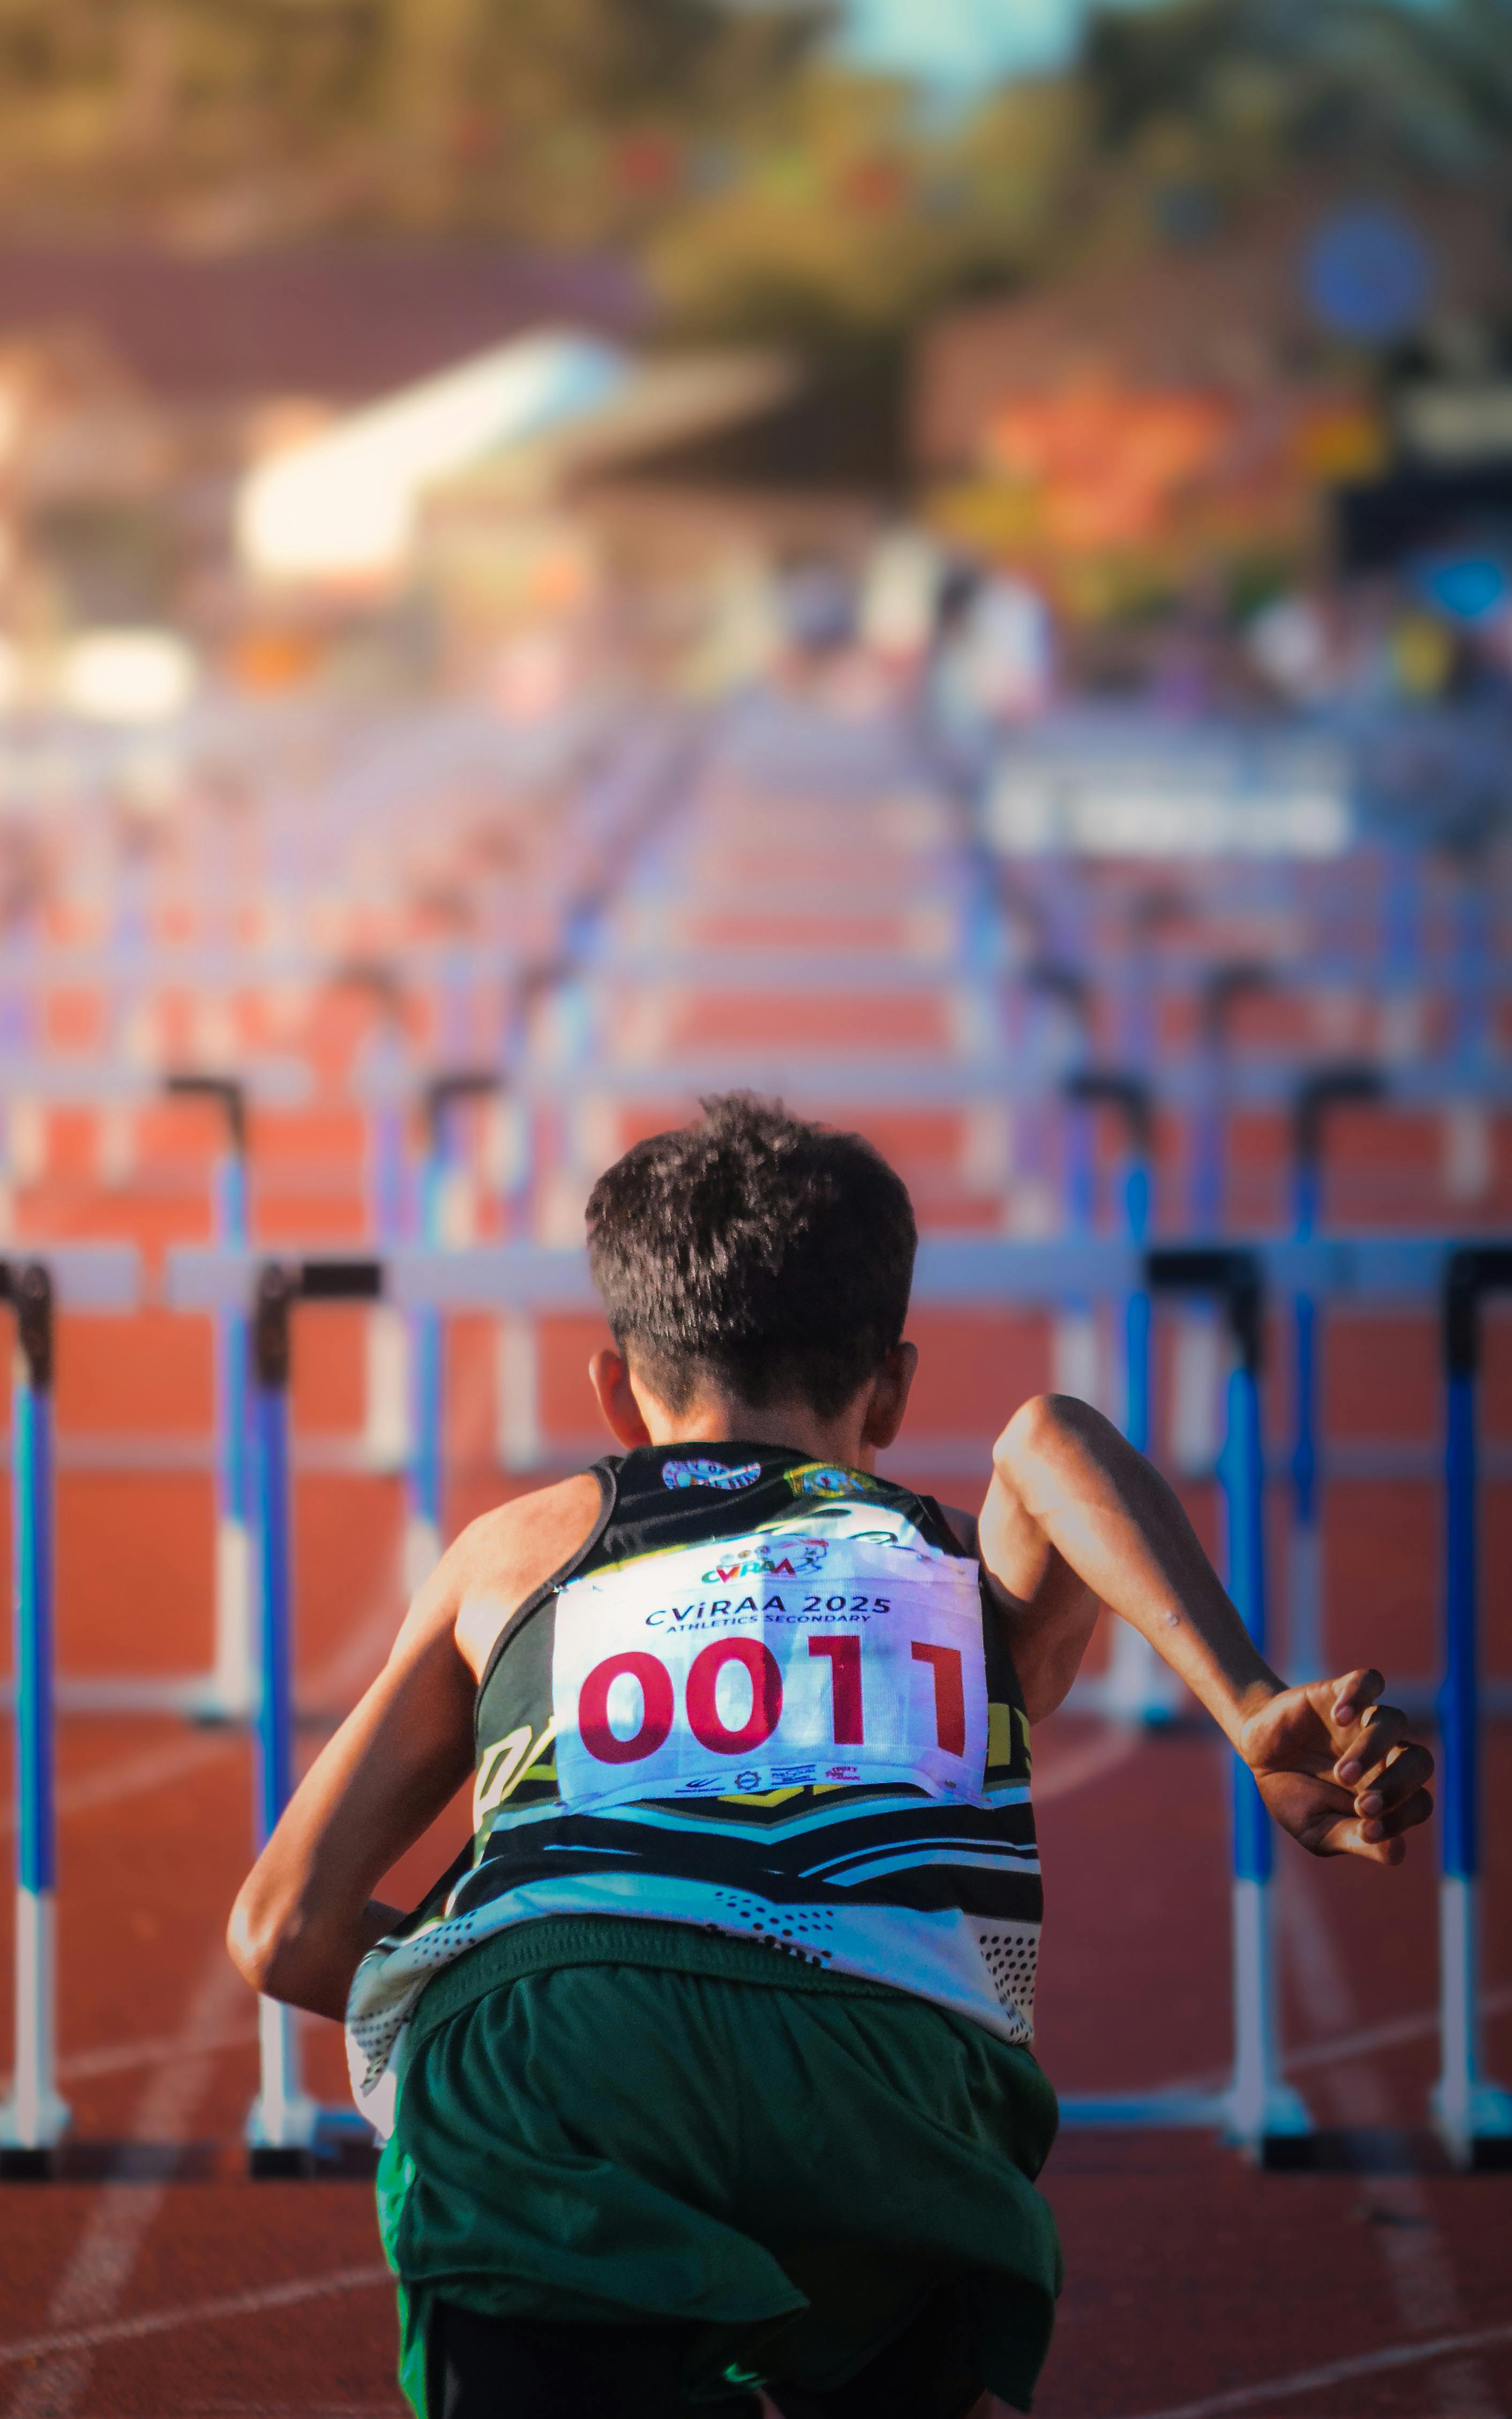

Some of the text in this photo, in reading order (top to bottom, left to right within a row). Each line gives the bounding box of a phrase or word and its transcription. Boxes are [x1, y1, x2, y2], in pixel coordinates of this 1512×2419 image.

[803, 1596, 890, 1614] 2025
[667, 1615, 871, 1633] ATHLETICS SECONDARY
[579, 1636, 965, 1764] 0011
